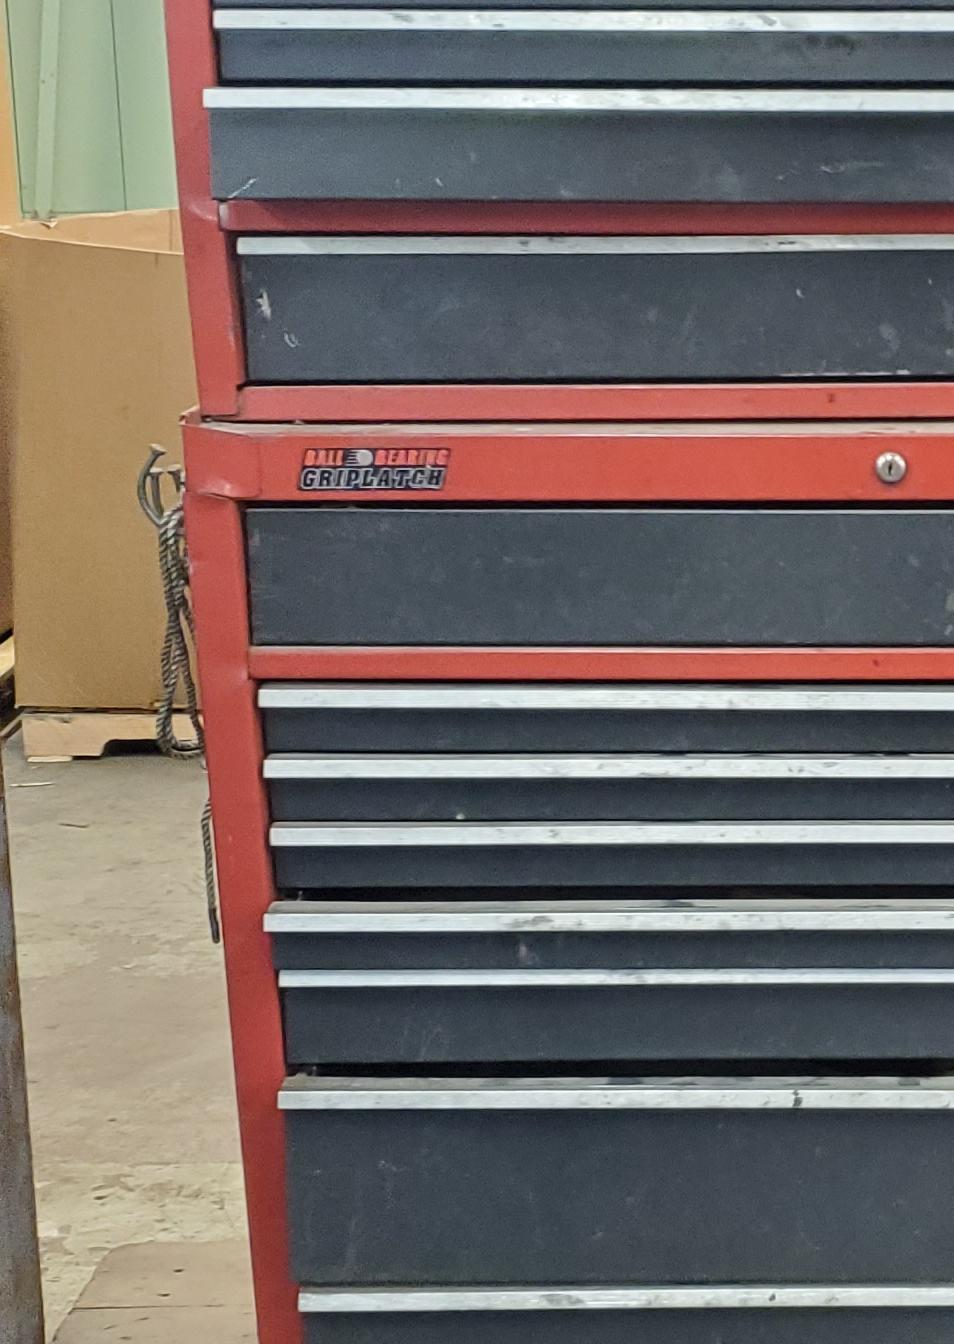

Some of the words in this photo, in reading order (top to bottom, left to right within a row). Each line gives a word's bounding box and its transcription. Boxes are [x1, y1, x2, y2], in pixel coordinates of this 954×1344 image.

[303, 448, 345, 466] BALL
[374, 448, 450, 466] BEARING
[300, 467, 446, 490] GRIPLATCH
